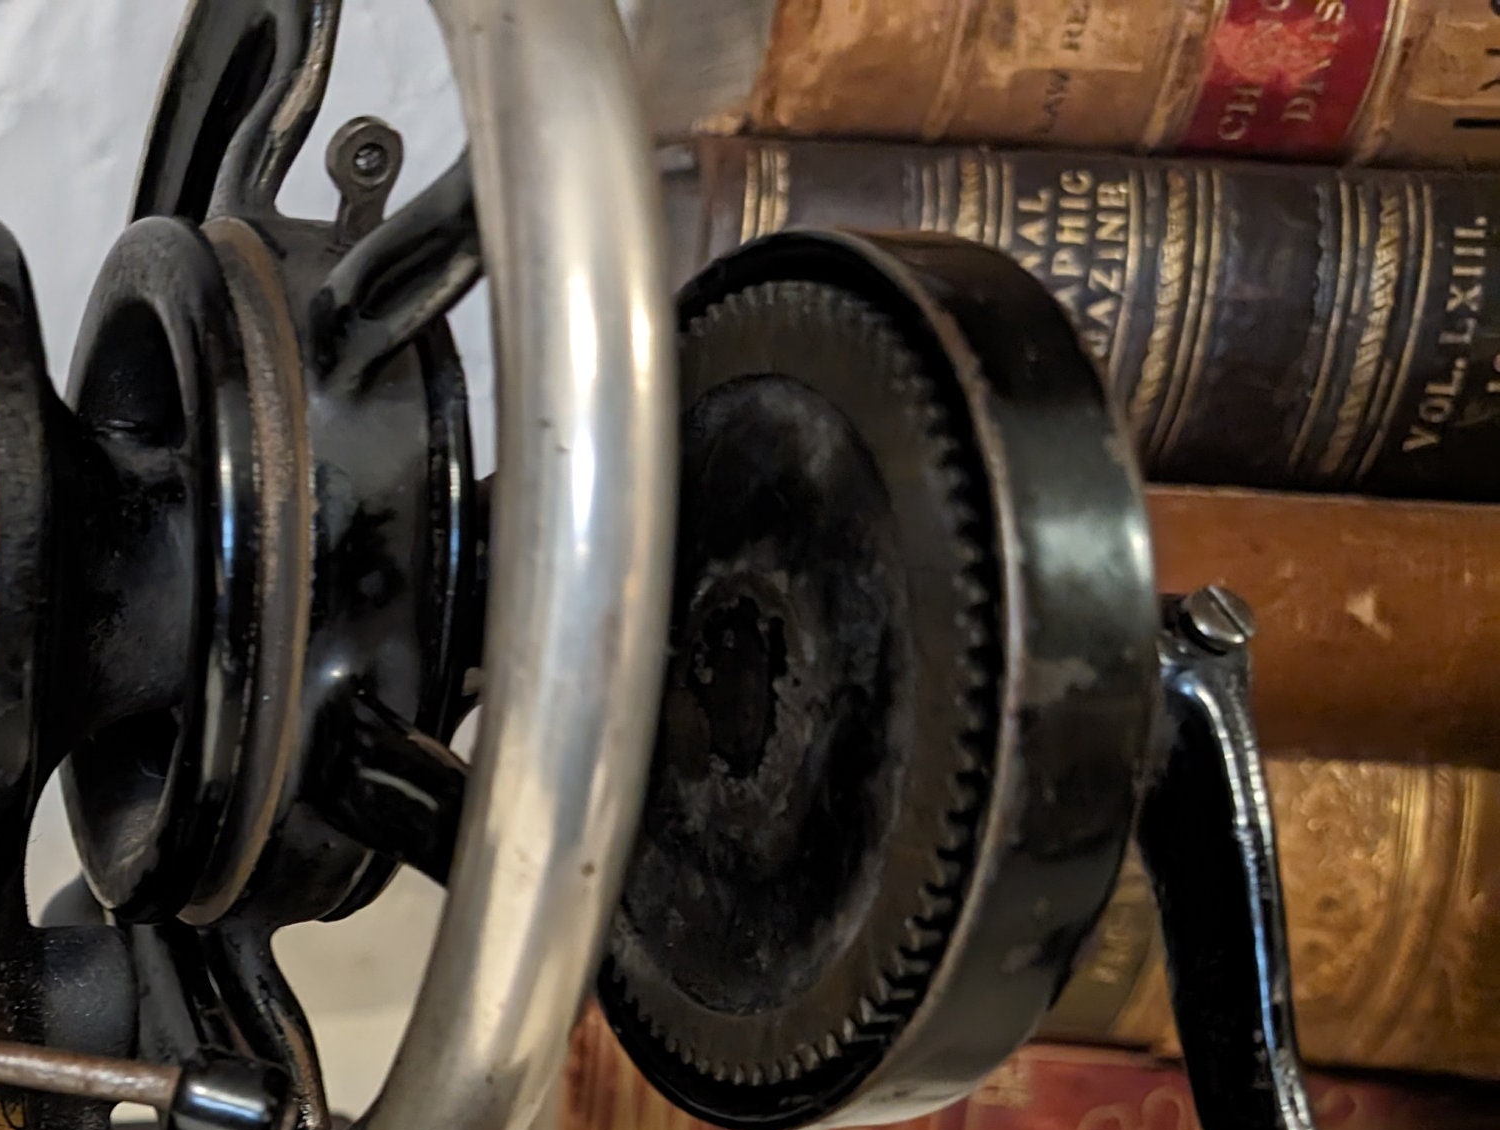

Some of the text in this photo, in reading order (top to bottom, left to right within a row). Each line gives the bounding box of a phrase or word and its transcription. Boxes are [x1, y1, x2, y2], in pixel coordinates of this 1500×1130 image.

[1052, 169, 1094, 324] APHIC
[1402, 215, 1488, 452] VOL. LXIII.
